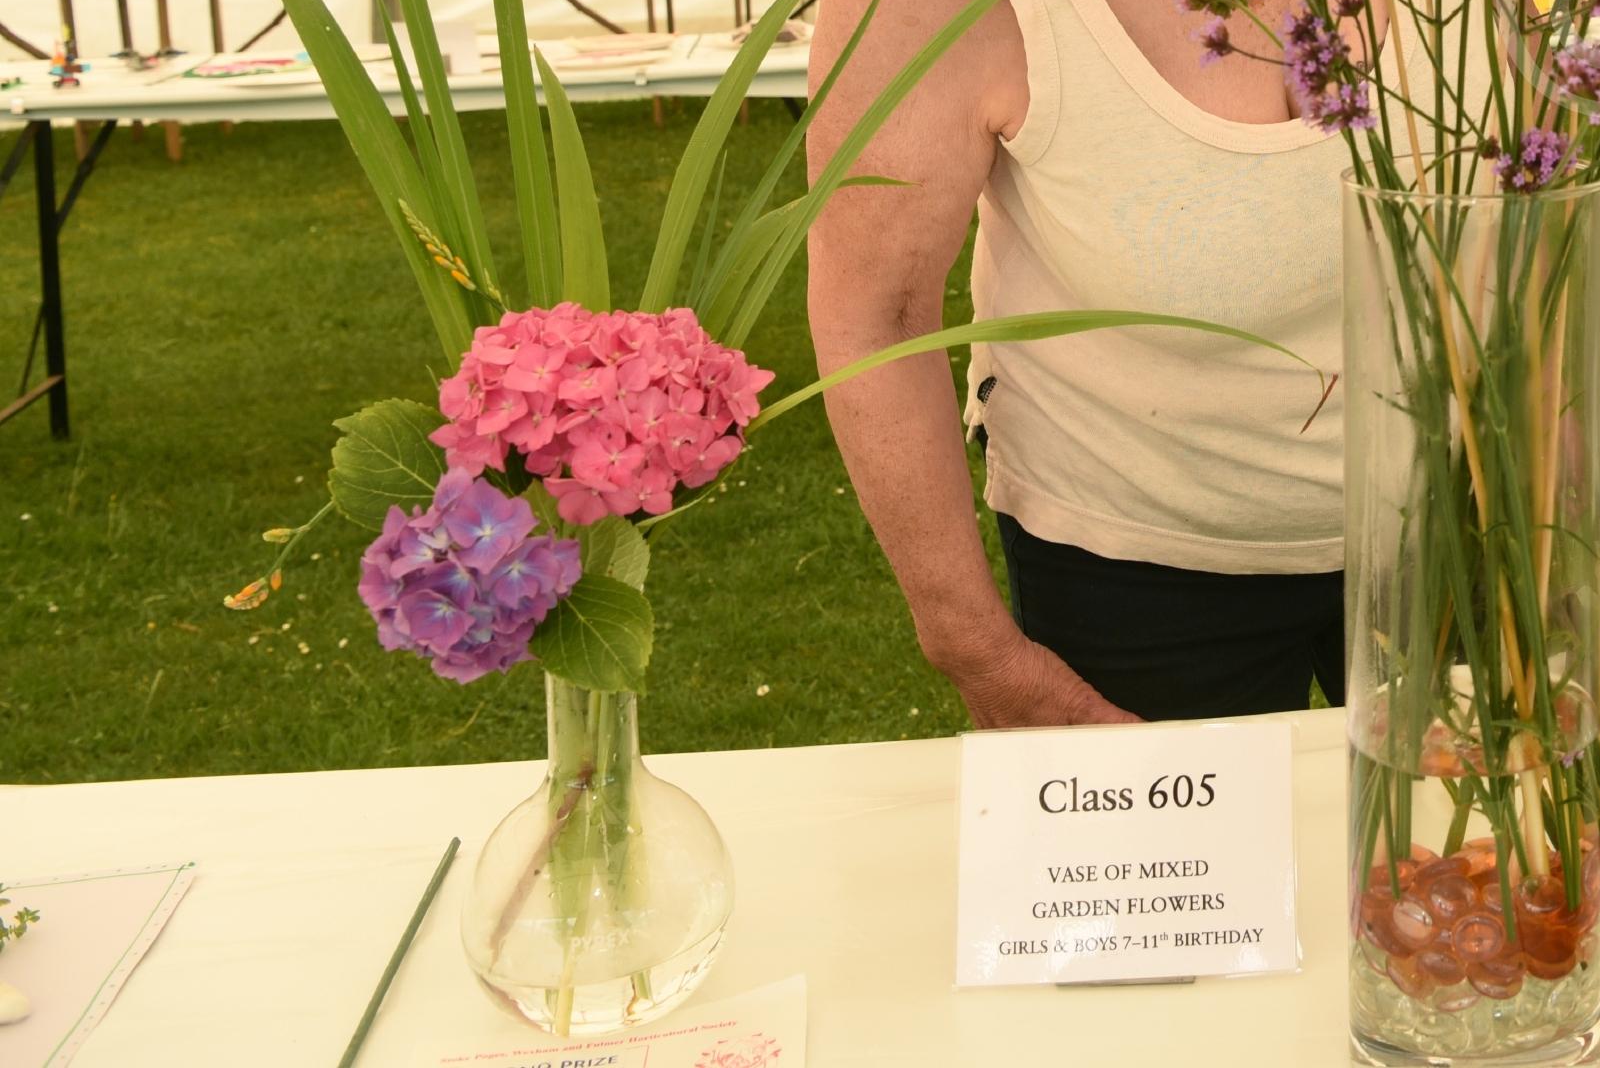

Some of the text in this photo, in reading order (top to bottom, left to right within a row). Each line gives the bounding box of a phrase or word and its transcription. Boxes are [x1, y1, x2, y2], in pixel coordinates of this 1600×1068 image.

[1038, 773, 1217, 814] Class 605
[1048, 859, 1209, 884] VASE OF MIXED
[1032, 893, 1226, 919] GARDEN FLOWERS
[999, 939, 1048, 956] GIRLS
[1054, 937, 1068, 953] &
[1075, 936, 1118, 952] BOYS
[1174, 928, 1264, 948] BIRTHDAY
[561, 1054, 619, 1068] PRIZE
